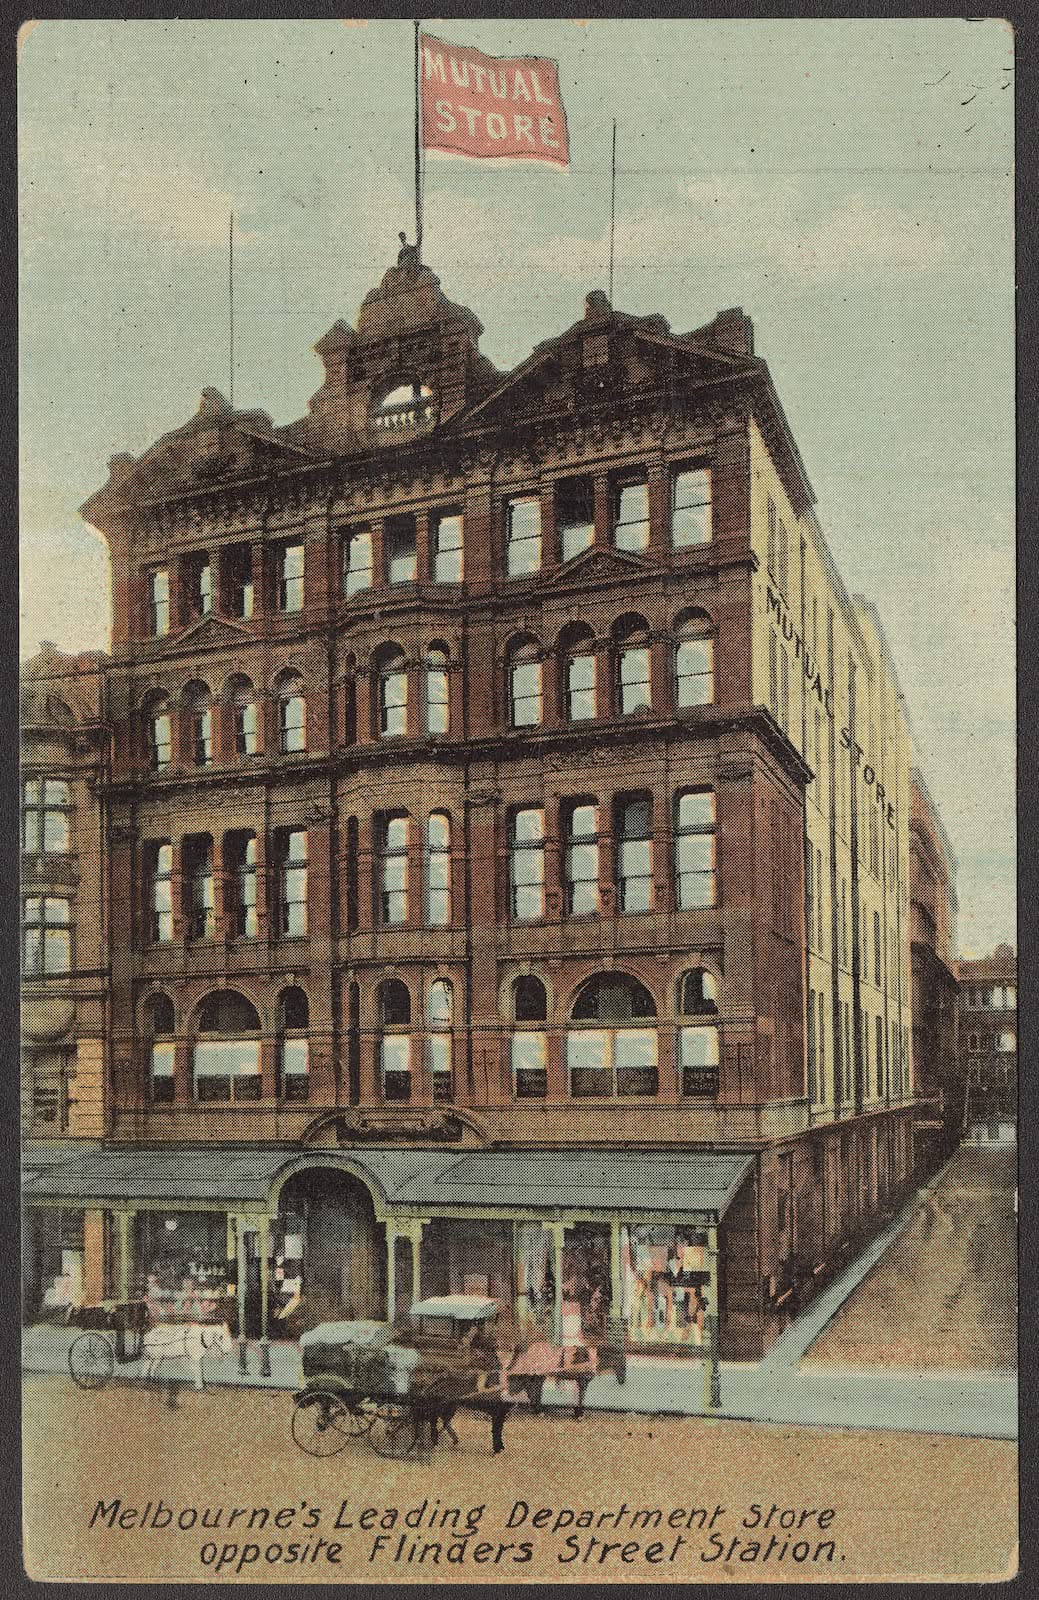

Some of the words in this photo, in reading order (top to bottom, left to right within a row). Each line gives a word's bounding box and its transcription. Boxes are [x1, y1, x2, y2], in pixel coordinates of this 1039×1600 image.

[422, 47, 551, 104] MUTUAL
[435, 99, 560, 148] STORE
[767, 585, 834, 719] MUTUAL
[838, 726, 894, 830] STORE
